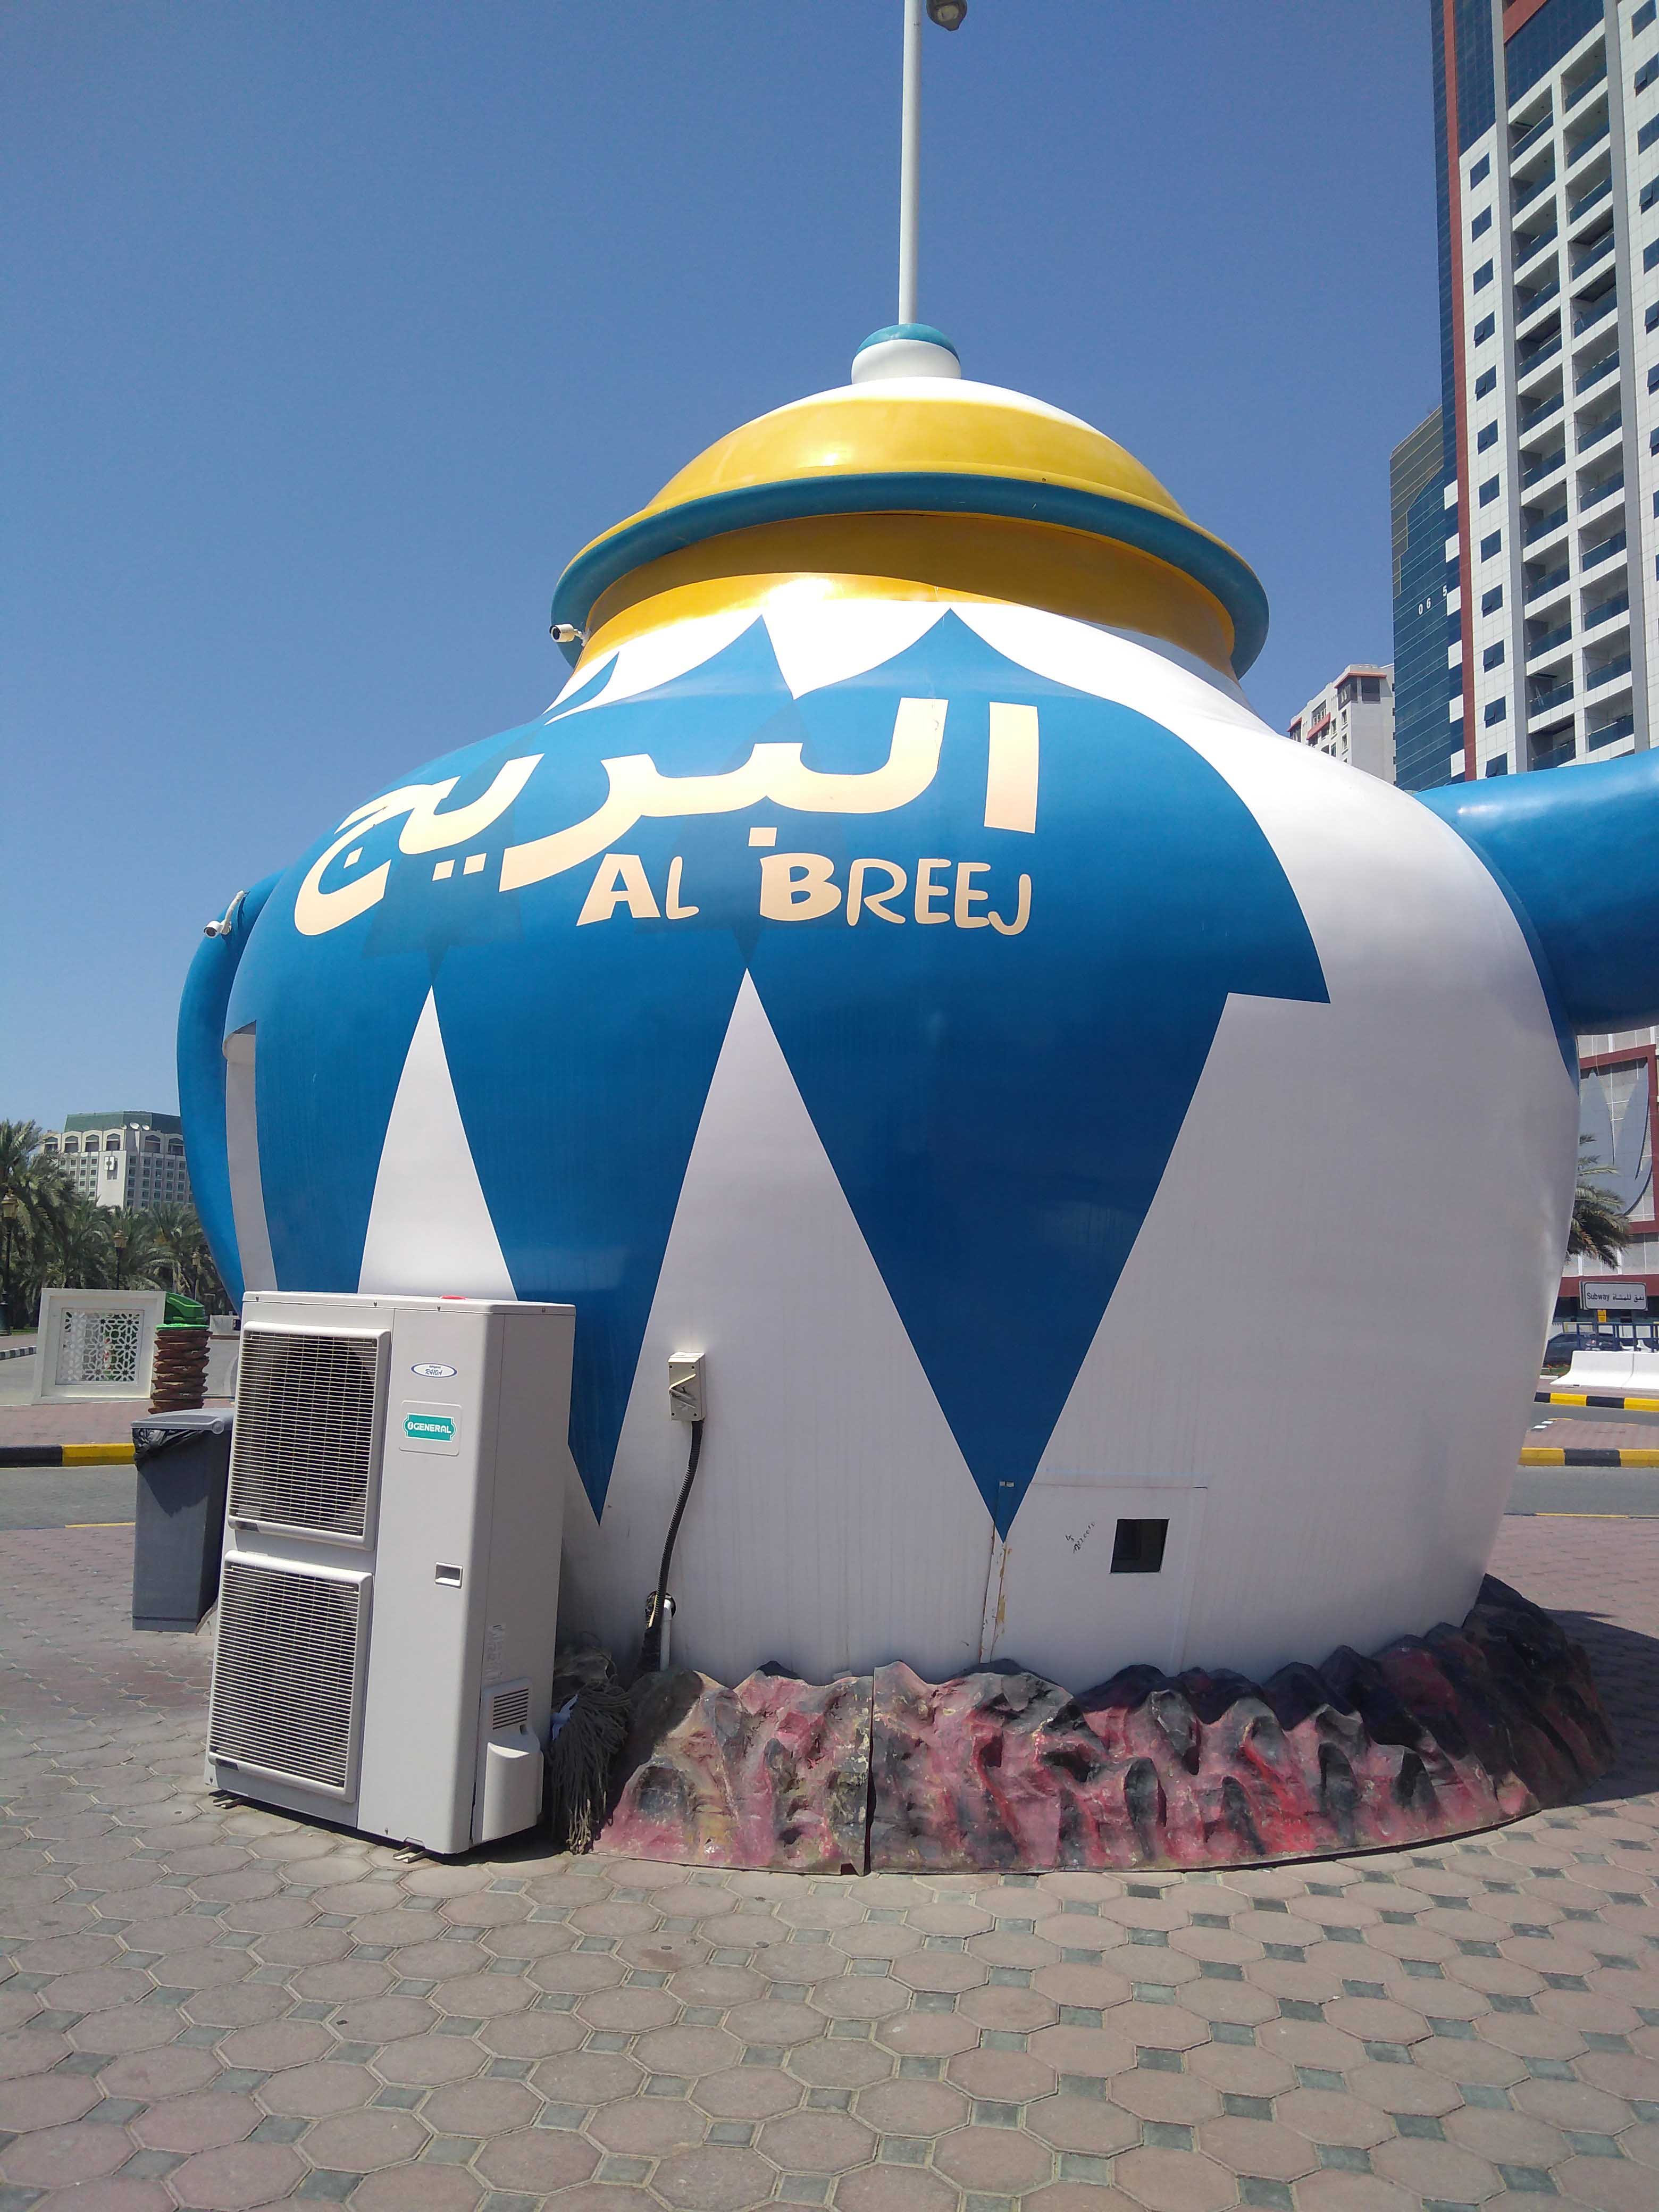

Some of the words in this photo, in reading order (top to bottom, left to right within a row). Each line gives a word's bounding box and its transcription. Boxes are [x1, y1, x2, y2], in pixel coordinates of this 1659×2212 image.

[294, 696, 1040, 936] البريج
[576, 852, 700, 927] AL
[758, 852, 1033, 936] BREEJ
[1586, 1292, 1610, 1302] Subway
